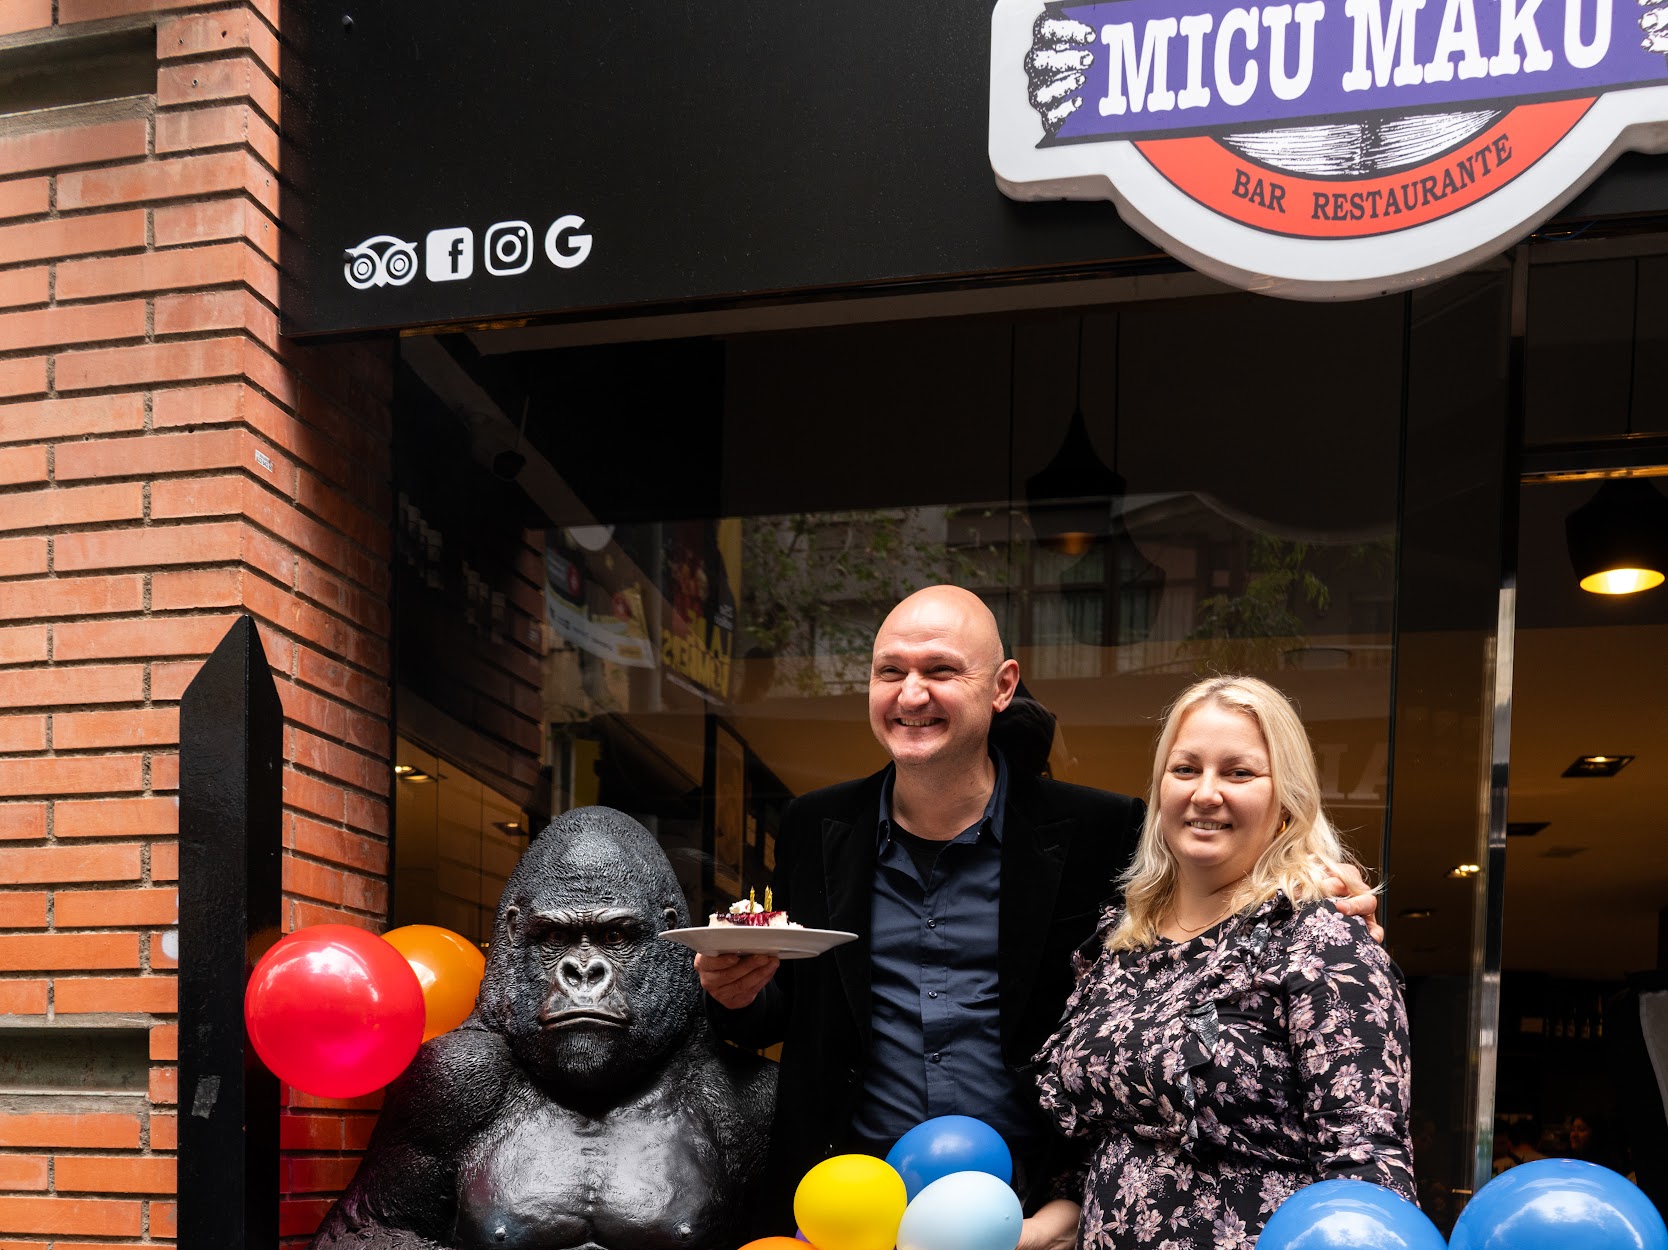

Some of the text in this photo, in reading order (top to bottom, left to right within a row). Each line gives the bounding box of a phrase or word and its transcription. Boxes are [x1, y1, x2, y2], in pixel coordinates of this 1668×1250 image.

[1099, 0, 1613, 116] MICU MAKU
[1232, 133, 1513, 221] BAR RESTAURANTE
